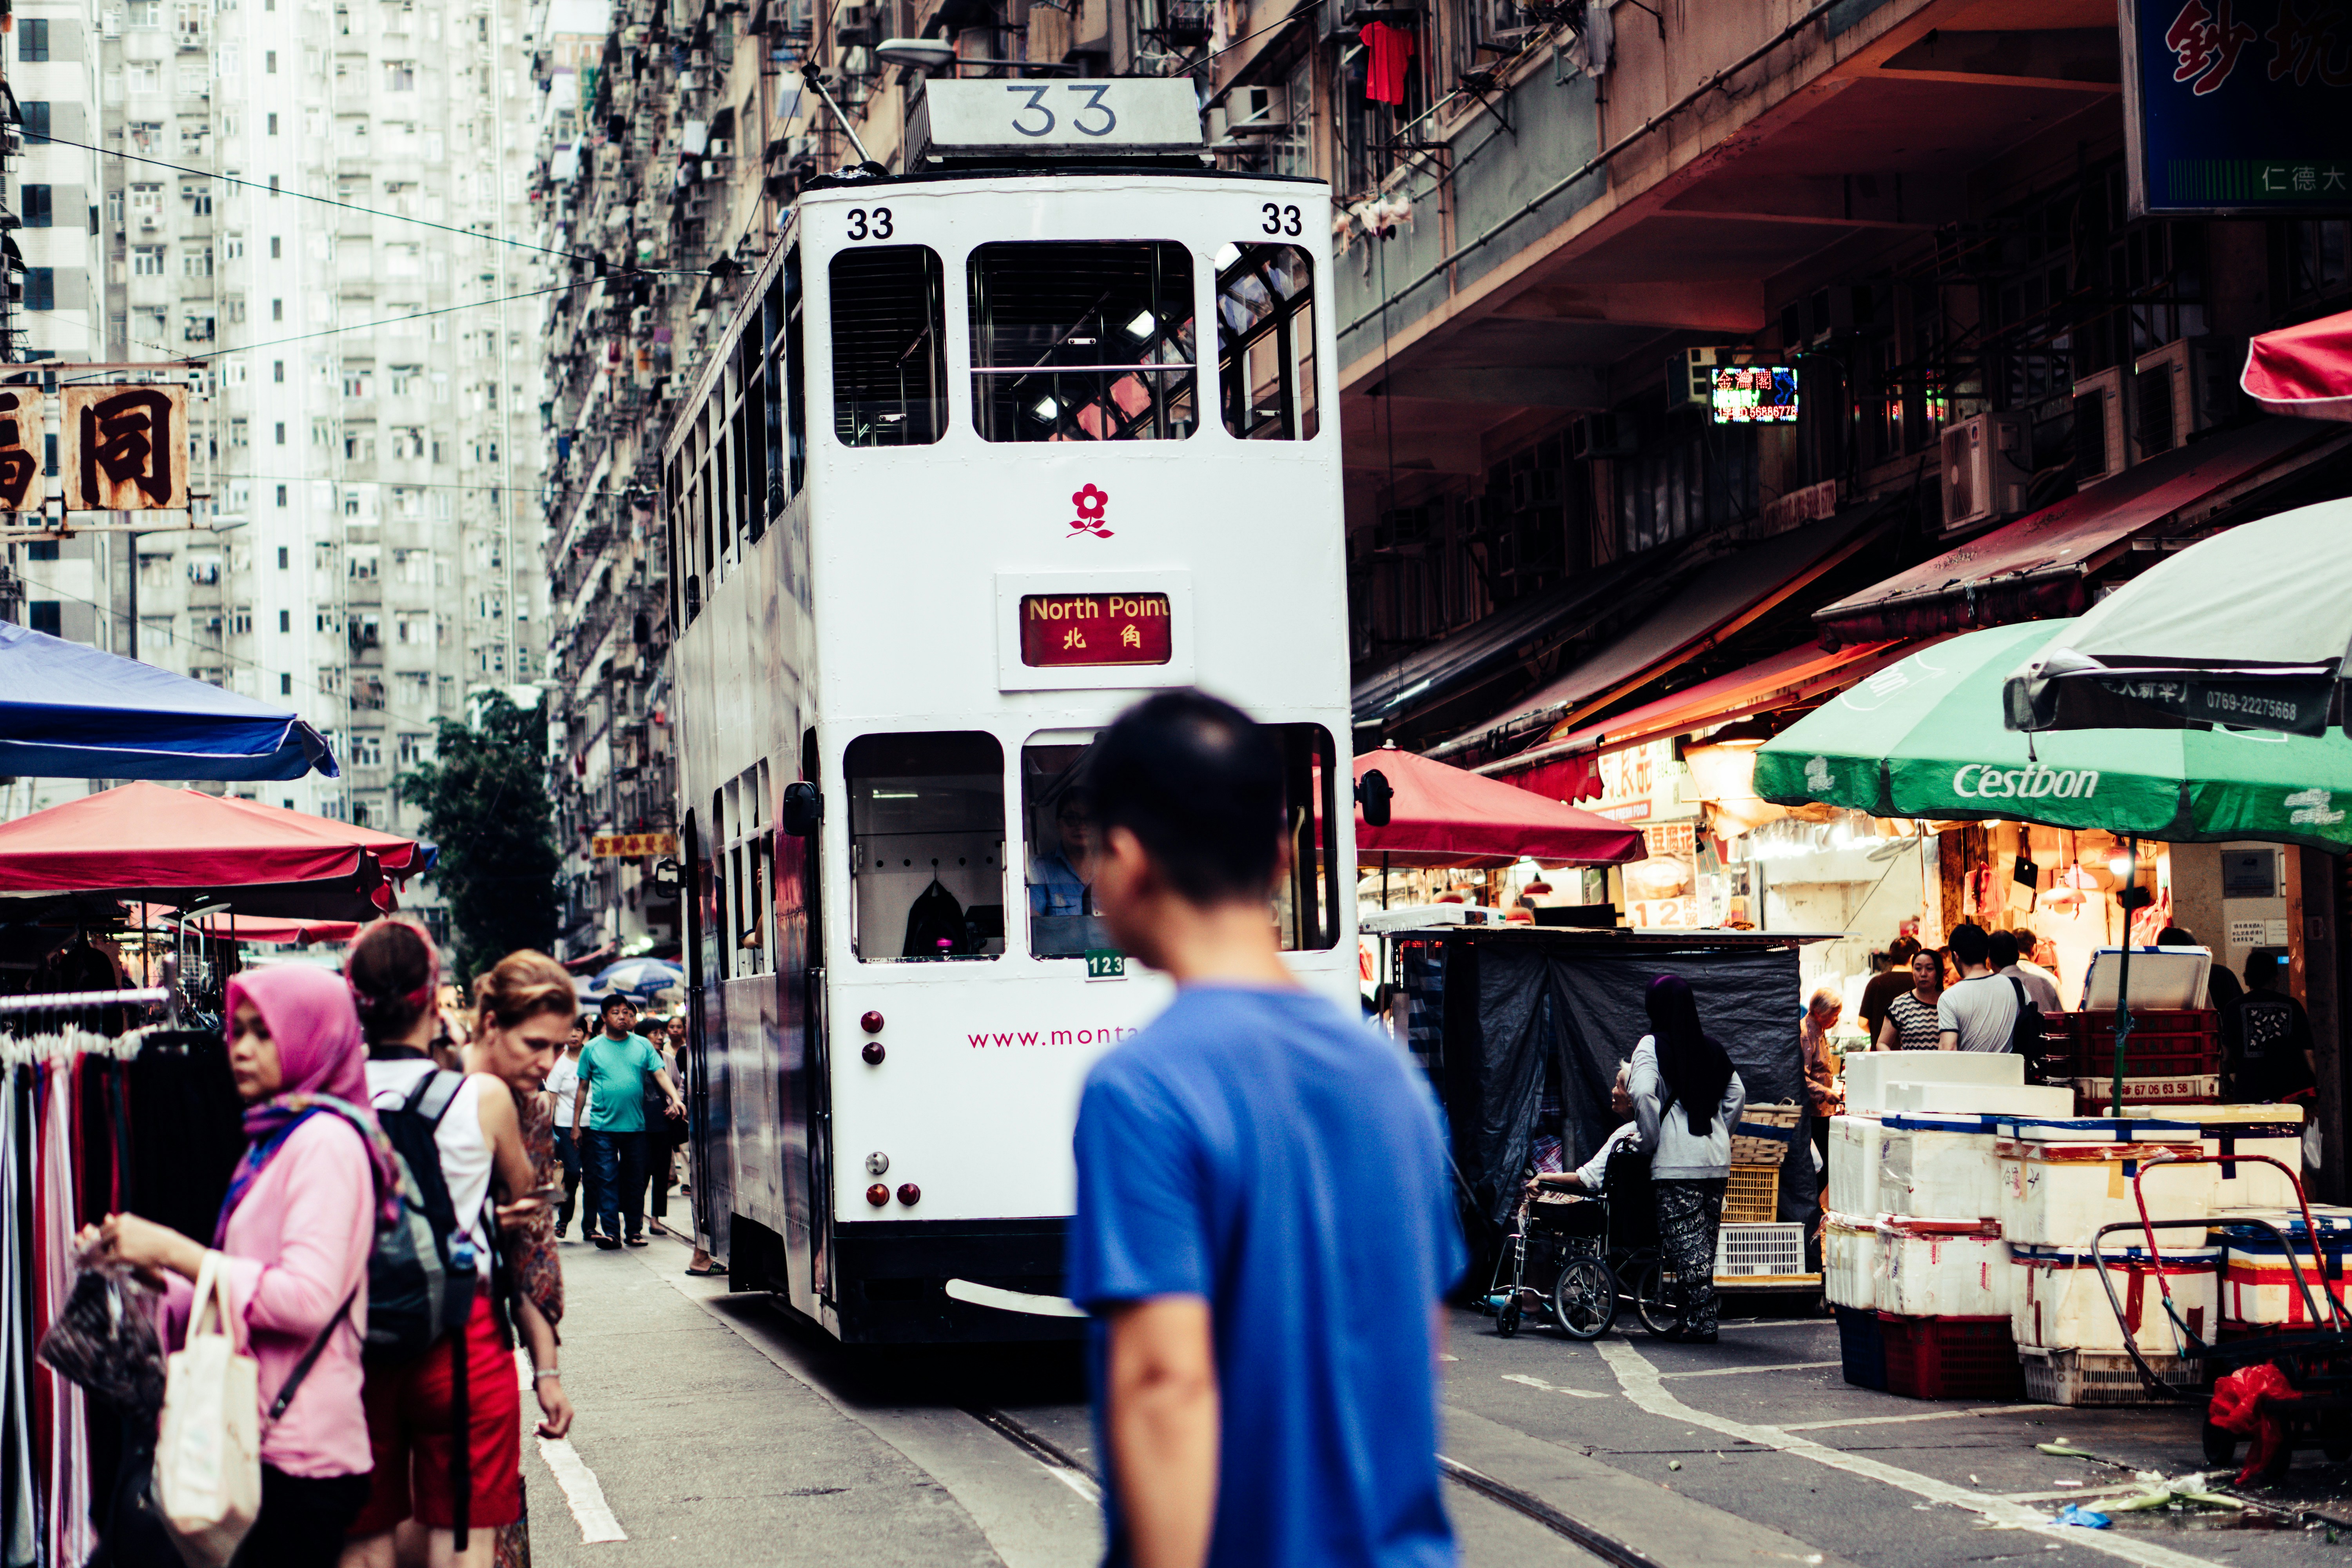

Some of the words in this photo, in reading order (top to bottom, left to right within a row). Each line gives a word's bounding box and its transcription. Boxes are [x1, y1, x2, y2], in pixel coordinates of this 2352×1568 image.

[1006, 85, 1116, 137] 33
[2262, 165, 2346, 191] 仁德大
[847, 207, 893, 240] 33
[1262, 203, 1302, 236] 33
[1030, 597, 1098, 620] North
[1110, 595, 1169, 617] Point
[1063, 624, 1141, 650] 北角
[2207, 690, 2298, 721] 0769-22275668
[1633, 803, 1648, 817] FOOD
[1089, 956, 1123, 974] 123
[2134, 1085, 2145, 1095] 67
[2148, 1085, 2159, 1095] 06
[2163, 1084, 2174, 1094] 63
[2177, 1083, 2188, 1093] 58
